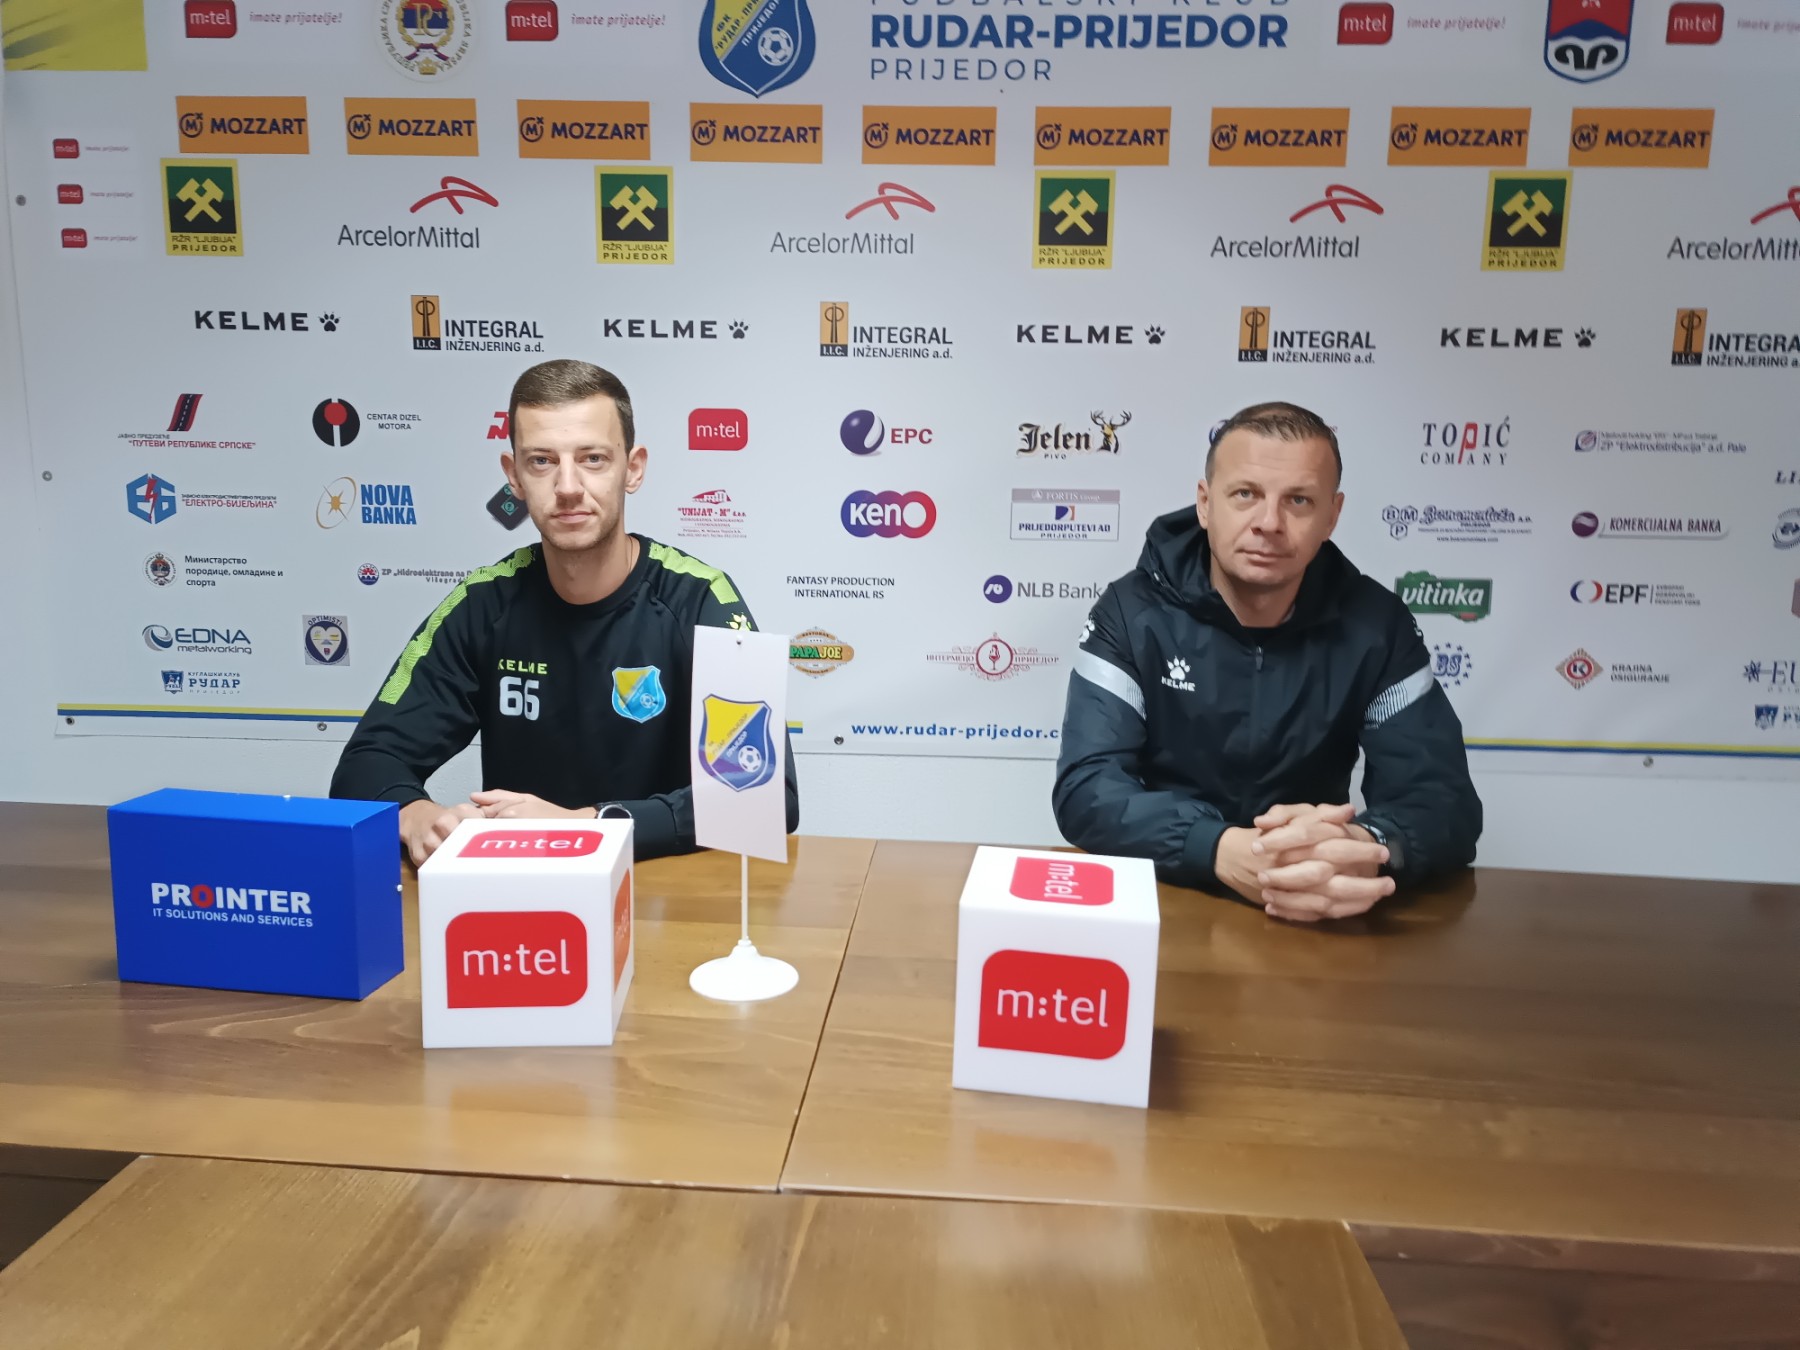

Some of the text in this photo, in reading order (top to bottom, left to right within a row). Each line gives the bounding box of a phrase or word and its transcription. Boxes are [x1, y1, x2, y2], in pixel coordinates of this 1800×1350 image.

[190, 9, 231, 25] m:tel
[250, 12, 281, 23] imate
[511, 11, 552, 29] m:tel
[571, 13, 666, 28] imate prijatelje!
[1344, 13, 1387, 32] m:tel
[1673, 13, 1717, 32] m:tel
[871, 13, 1288, 49] RUDAR-PRIJEDOR
[870, 58, 1052, 82] PRIJEDOR
[210, 118, 306, 135] MOZZART
[379, 119, 475, 137] MOZZART
[551, 122, 648, 140] MOZZART
[723, 125, 821, 144] MOZZART
[896, 128, 994, 147] MOZZART
[1068, 128, 1169, 146] MOZZART
[1244, 129, 1347, 148] MOZZART
[1424, 129, 1528, 148] MOZZART
[1604, 129, 1711, 149] MOZZART
[337, 224, 480, 249] ArcelorMittal
[770, 232, 914, 255] ArcelorMittal
[173, 244, 237, 252] PRIJEDOR
[603, 242, 622, 251] RŽR
[1211, 235, 1360, 258] ArcelorMittal
[1667, 235, 1800, 260] ArcelorMitt
[603, 252, 668, 260] PRIJEDOR
[1039, 257, 1105, 265] PRIJEDOR
[1488, 259, 1557, 268] PRIJEDOR
[195, 310, 309, 331] KELME
[445, 320, 544, 339] INTEGRAL
[603, 318, 718, 340] KELME
[853, 326, 953, 345] INTEGRAL
[1016, 324, 1134, 345] KELME
[1273, 331, 1376, 349] INTEGRAL
[1440, 328, 1563, 348] KELME
[445, 338, 544, 353] INŽENJERING a.d.
[853, 344, 953, 359] INŽENJERING a.d.
[1272, 349, 1375, 364] INŽENJERING a.d.
[367, 413, 398, 421] CENTAR
[696, 421, 740, 438] m:tel
[891, 428, 933, 444] EPC
[168, 440, 217, 449] РЕПУБЛИКЕ
[1016, 423, 1091, 455] Jelen
[360, 483, 414, 506] NOVA
[1046, 491, 1078, 501] FORTIS
[362, 506, 417, 525] BANKA
[1609, 517, 1721, 533] KOMERCIJALNA BANKA
[185, 555, 247, 565] Министарство
[232, 569, 276, 577] омладине
[786, 576, 895, 586] FANTASY PRODUCTION
[186, 579, 216, 587] спорта
[1017, 582, 1054, 597] NLB
[794, 589, 884, 599] INTERNATIONAL RS
[1402, 582, 1485, 606] vitinka
[1605, 584, 1649, 604] EPF
[308, 615, 343, 626] OPTIMISTI
[175, 628, 251, 644] EDNA
[177, 644, 252, 655] metalworking
[789, 645, 842, 660] PAPA JOE
[498, 659, 548, 675] KELME
[1612, 663, 1653, 673] KRAJINA
[189, 678, 241, 688] РУДАР
[499, 676, 540, 721] 66
[480, 837, 583, 849] m:tel
[1044, 863, 1083, 900] m:tel
[151, 882, 312, 915] PROINTER
[153, 908, 313, 927] IT SOLUTIONS AND SERVICES
[463, 939, 570, 976] m:tel
[997, 989, 1108, 1027] m:tel
